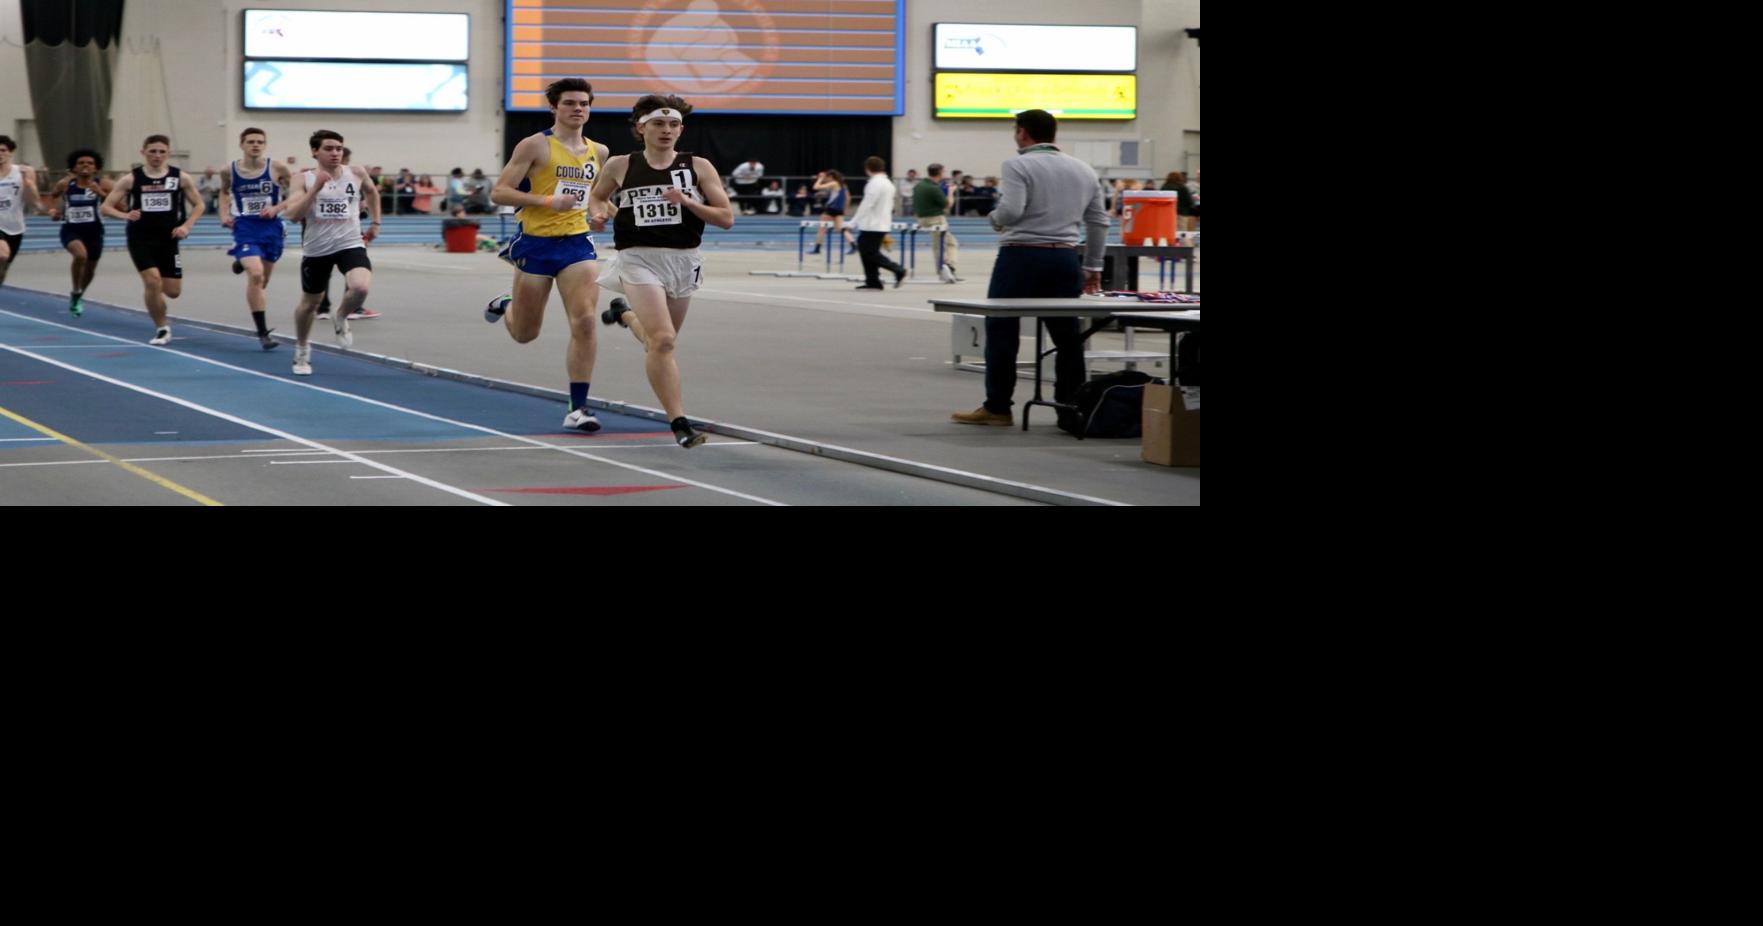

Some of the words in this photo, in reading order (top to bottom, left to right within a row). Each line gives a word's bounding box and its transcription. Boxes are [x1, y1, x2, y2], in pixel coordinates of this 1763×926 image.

[585, 163, 594, 180] 3
[674, 170, 686, 188] 1
[12, 185, 19, 196] 7
[262, 182, 271, 194] 6
[345, 183, 355, 196] 4
[320, 203, 347, 214] 1362
[636, 203, 678, 219] 1315
[693, 265, 701, 284] 1
[970, 326, 980, 348] 2
